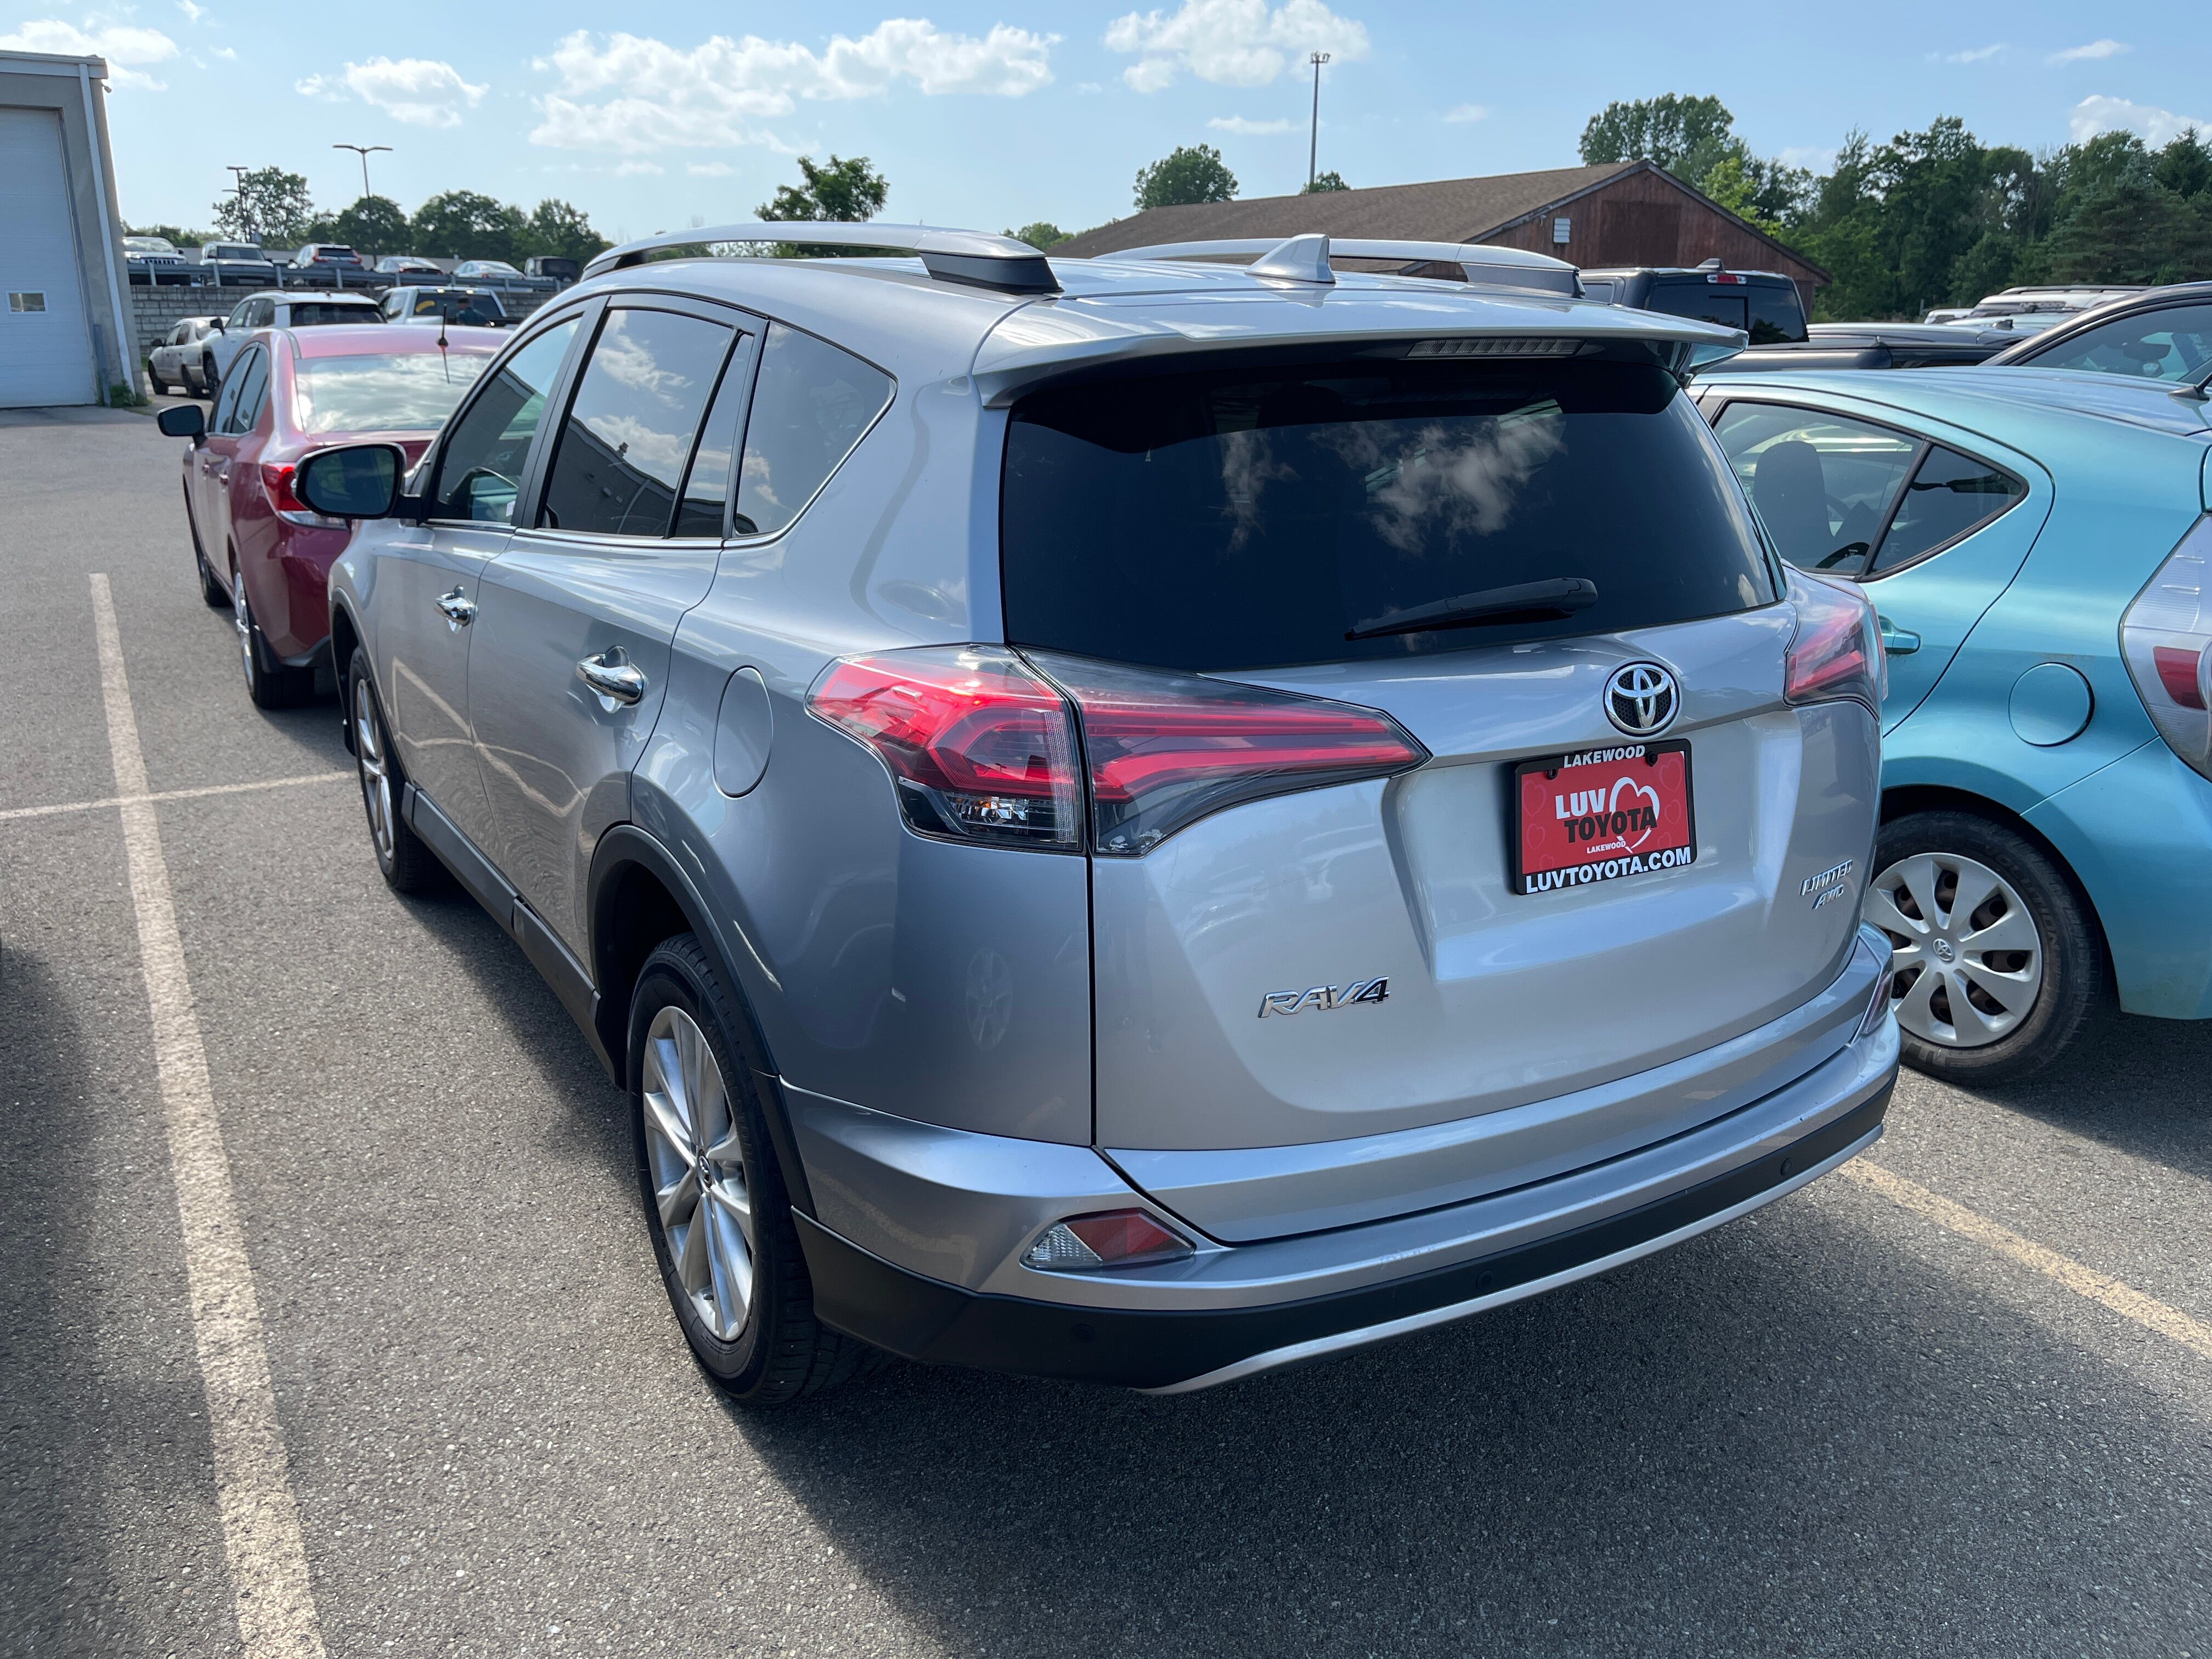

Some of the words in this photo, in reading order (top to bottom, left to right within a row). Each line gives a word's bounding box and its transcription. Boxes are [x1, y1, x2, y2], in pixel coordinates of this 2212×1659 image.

[1564, 745, 1645, 768] LAKEWOOD
[1555, 788, 1606, 820] LUV
[1564, 806, 1657, 843] TOYOTA
[1587, 840, 1627, 854] LAKEWOOD
[1525, 847, 1691, 894] LUVTOYOTA.COM
[1799, 859, 1853, 896] LIMITED
[1812, 884, 1844, 910] AWD
[1257, 976, 1391, 1018] RAV4
